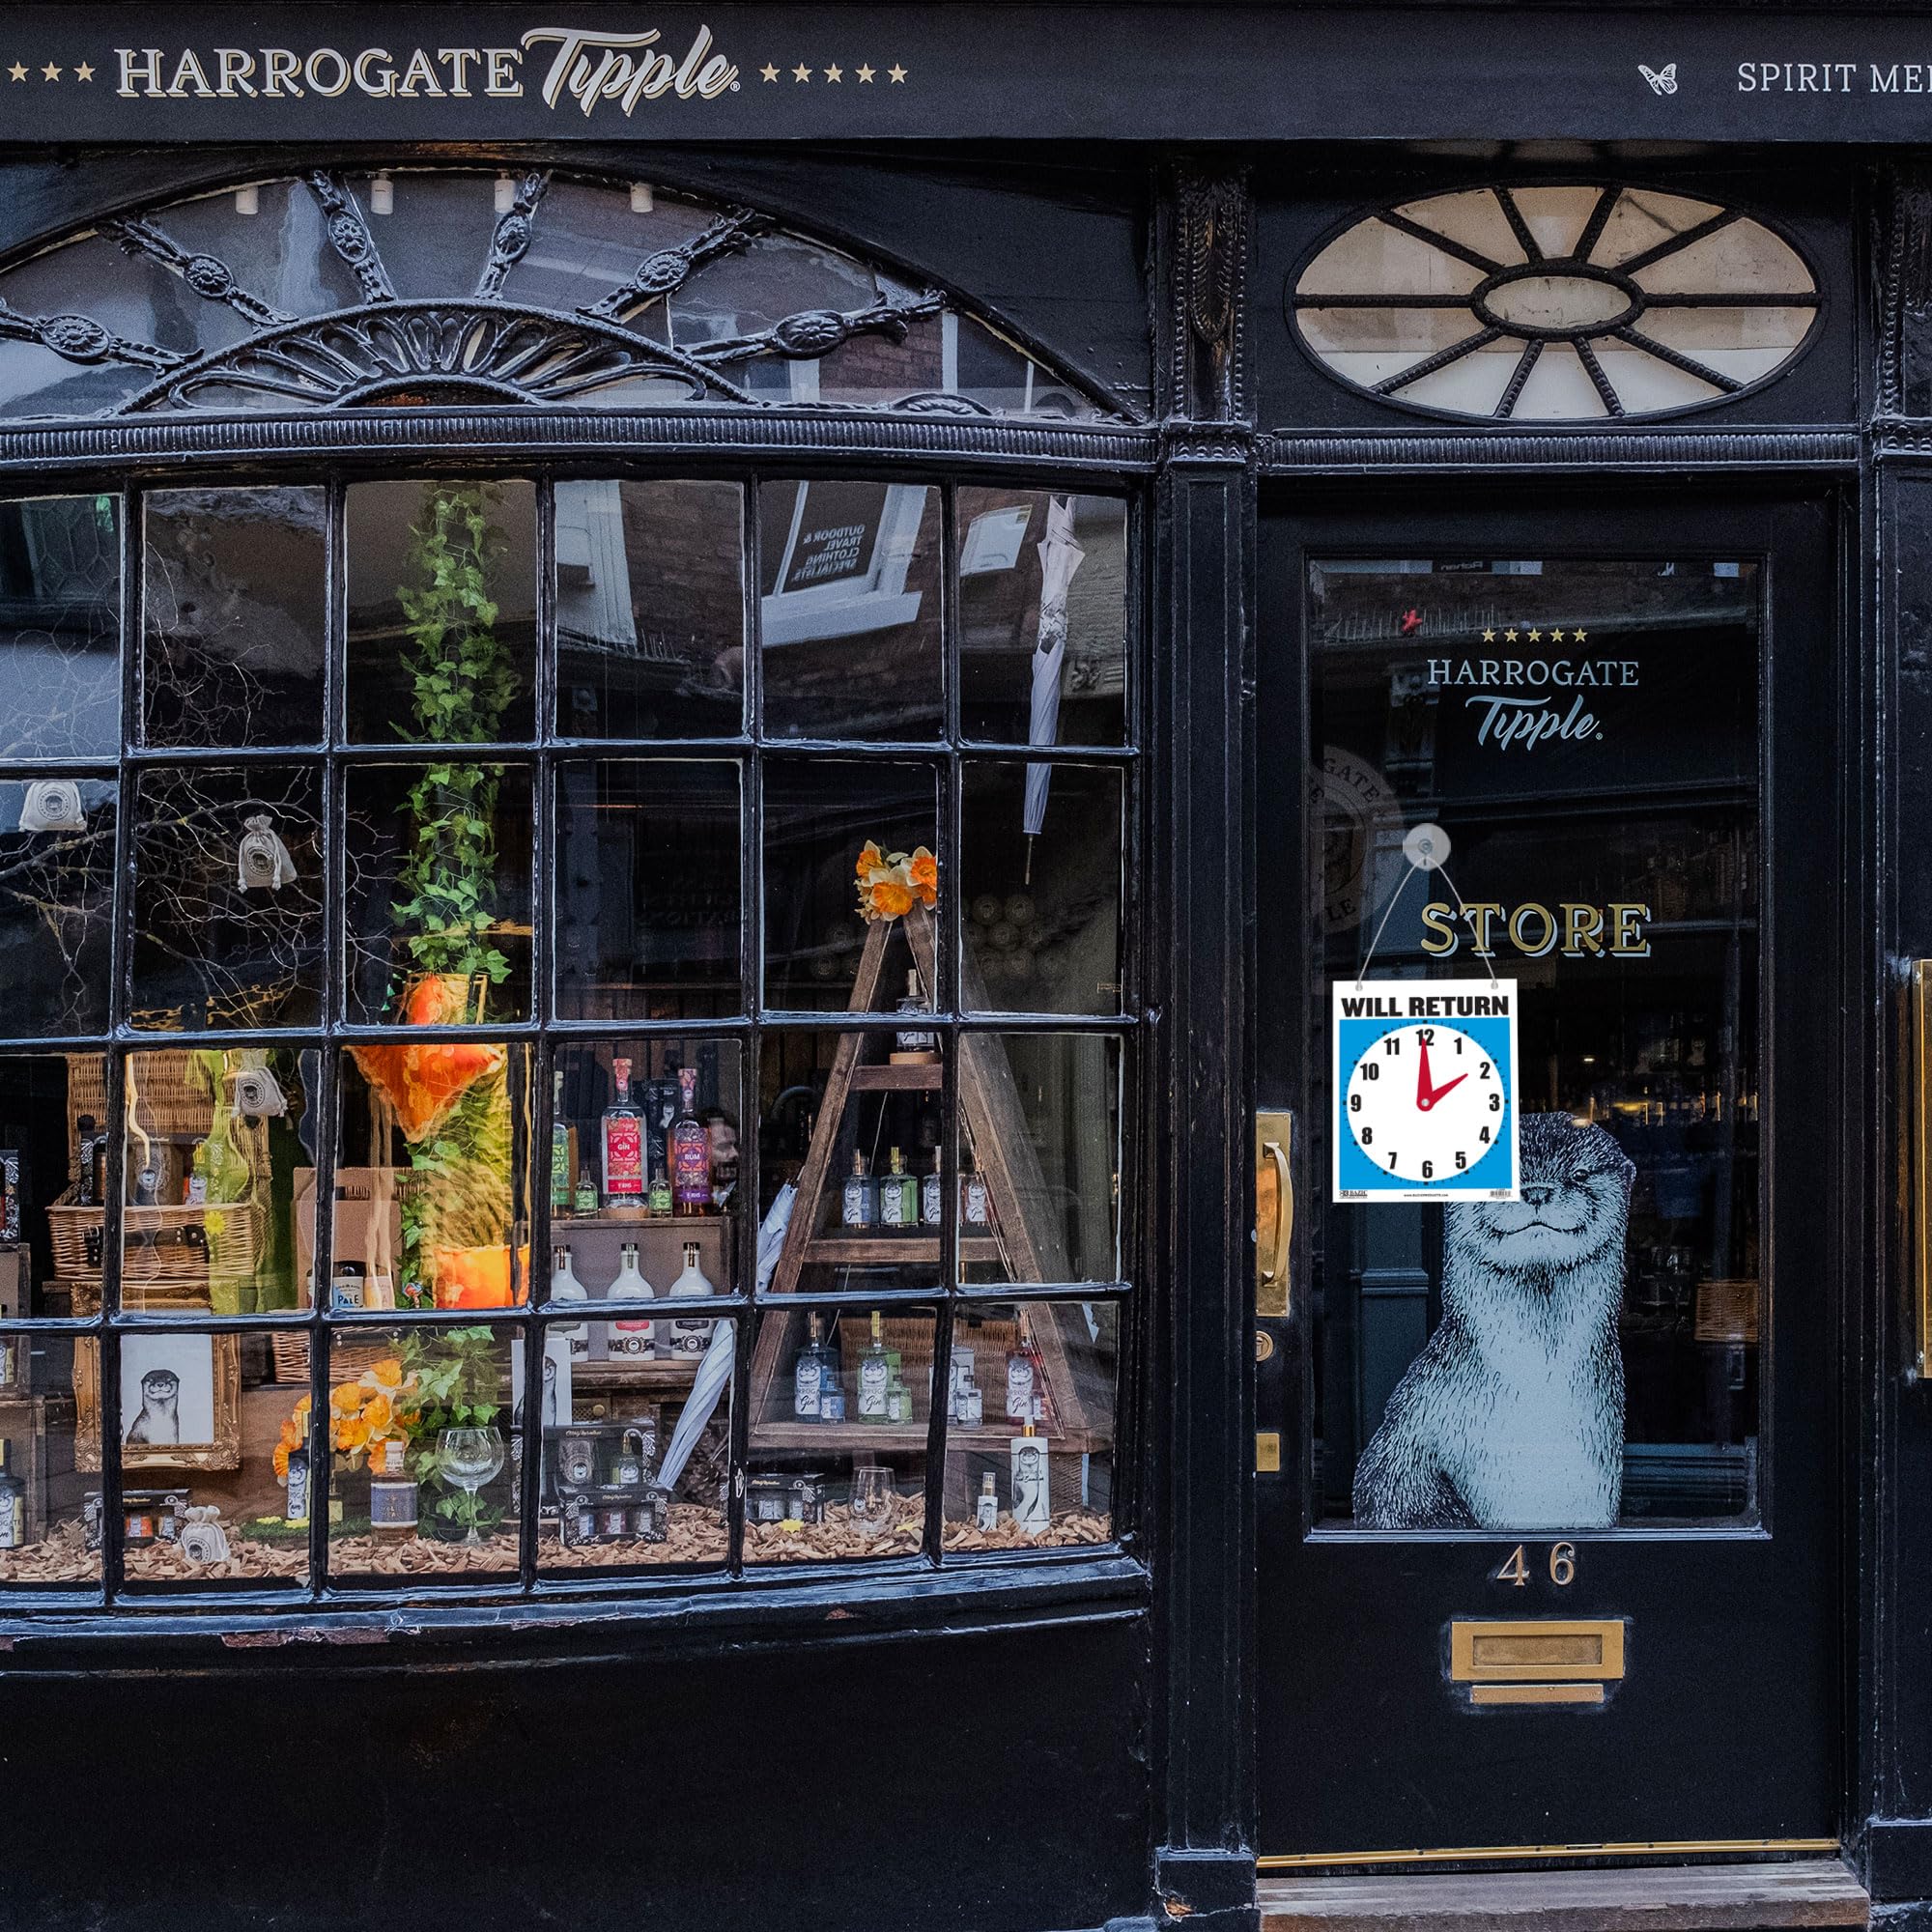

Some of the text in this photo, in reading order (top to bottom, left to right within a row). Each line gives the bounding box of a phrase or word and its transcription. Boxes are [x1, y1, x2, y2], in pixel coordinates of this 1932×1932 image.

[114, 47, 523, 99] HARROGATE
[1738, 63, 1932, 94] SPIRIT ME
[1427, 659, 1639, 687] HARROGATE
[1420, 902, 1652, 959] STORE
[1341, 995, 1509, 1017] WILL RETURN
[1383, 1037, 1401, 1056] 11
[1415, 1028, 1435, 1047] 12
[1453, 1037, 1463, 1055] 1
[1359, 1063, 1379, 1081] 10
[1479, 1062, 1491, 1080] 2
[1350, 1094, 1362, 1113] 9
[1489, 1093, 1500, 1112] 3
[1361, 1126, 1373, 1145] 8
[1479, 1125, 1491, 1145] 4
[1388, 1151, 1398, 1170] 7
[1422, 1160, 1434, 1179] 6
[1455, 1151, 1466, 1170] 5
[338, 1294, 359, 1304] PALE
[800, 1394, 815, 1412] Gin
[866, 1394, 882, 1412] Gin
[1011, 1396, 1028, 1414] Gin
